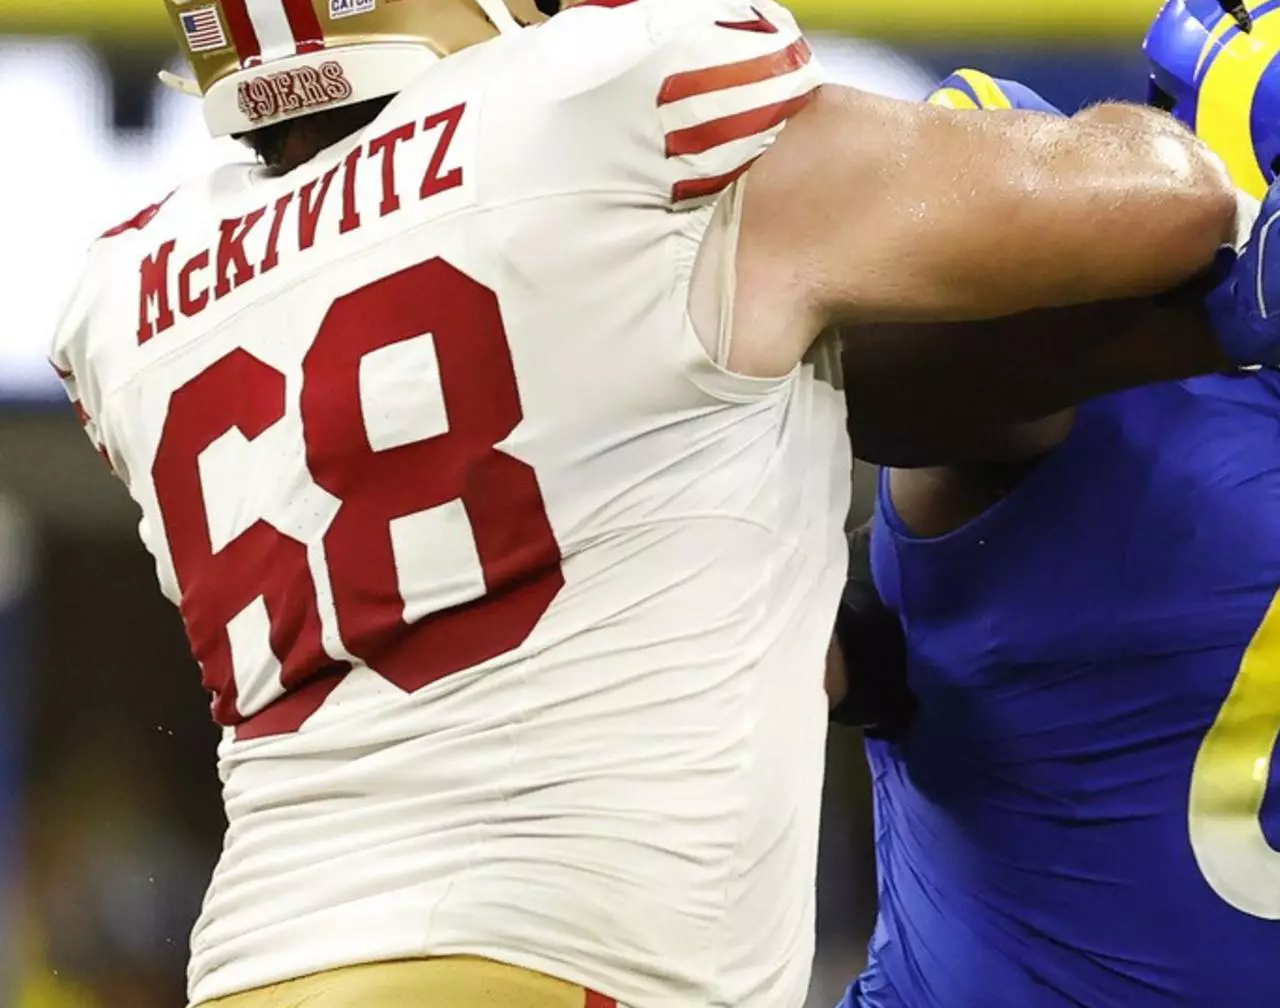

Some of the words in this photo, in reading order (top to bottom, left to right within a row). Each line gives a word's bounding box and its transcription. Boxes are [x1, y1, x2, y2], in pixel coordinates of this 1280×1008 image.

[237, 60, 353, 122] 49ERS
[135, 101, 467, 347] McKIVITZ
[151, 255, 566, 742] 68
